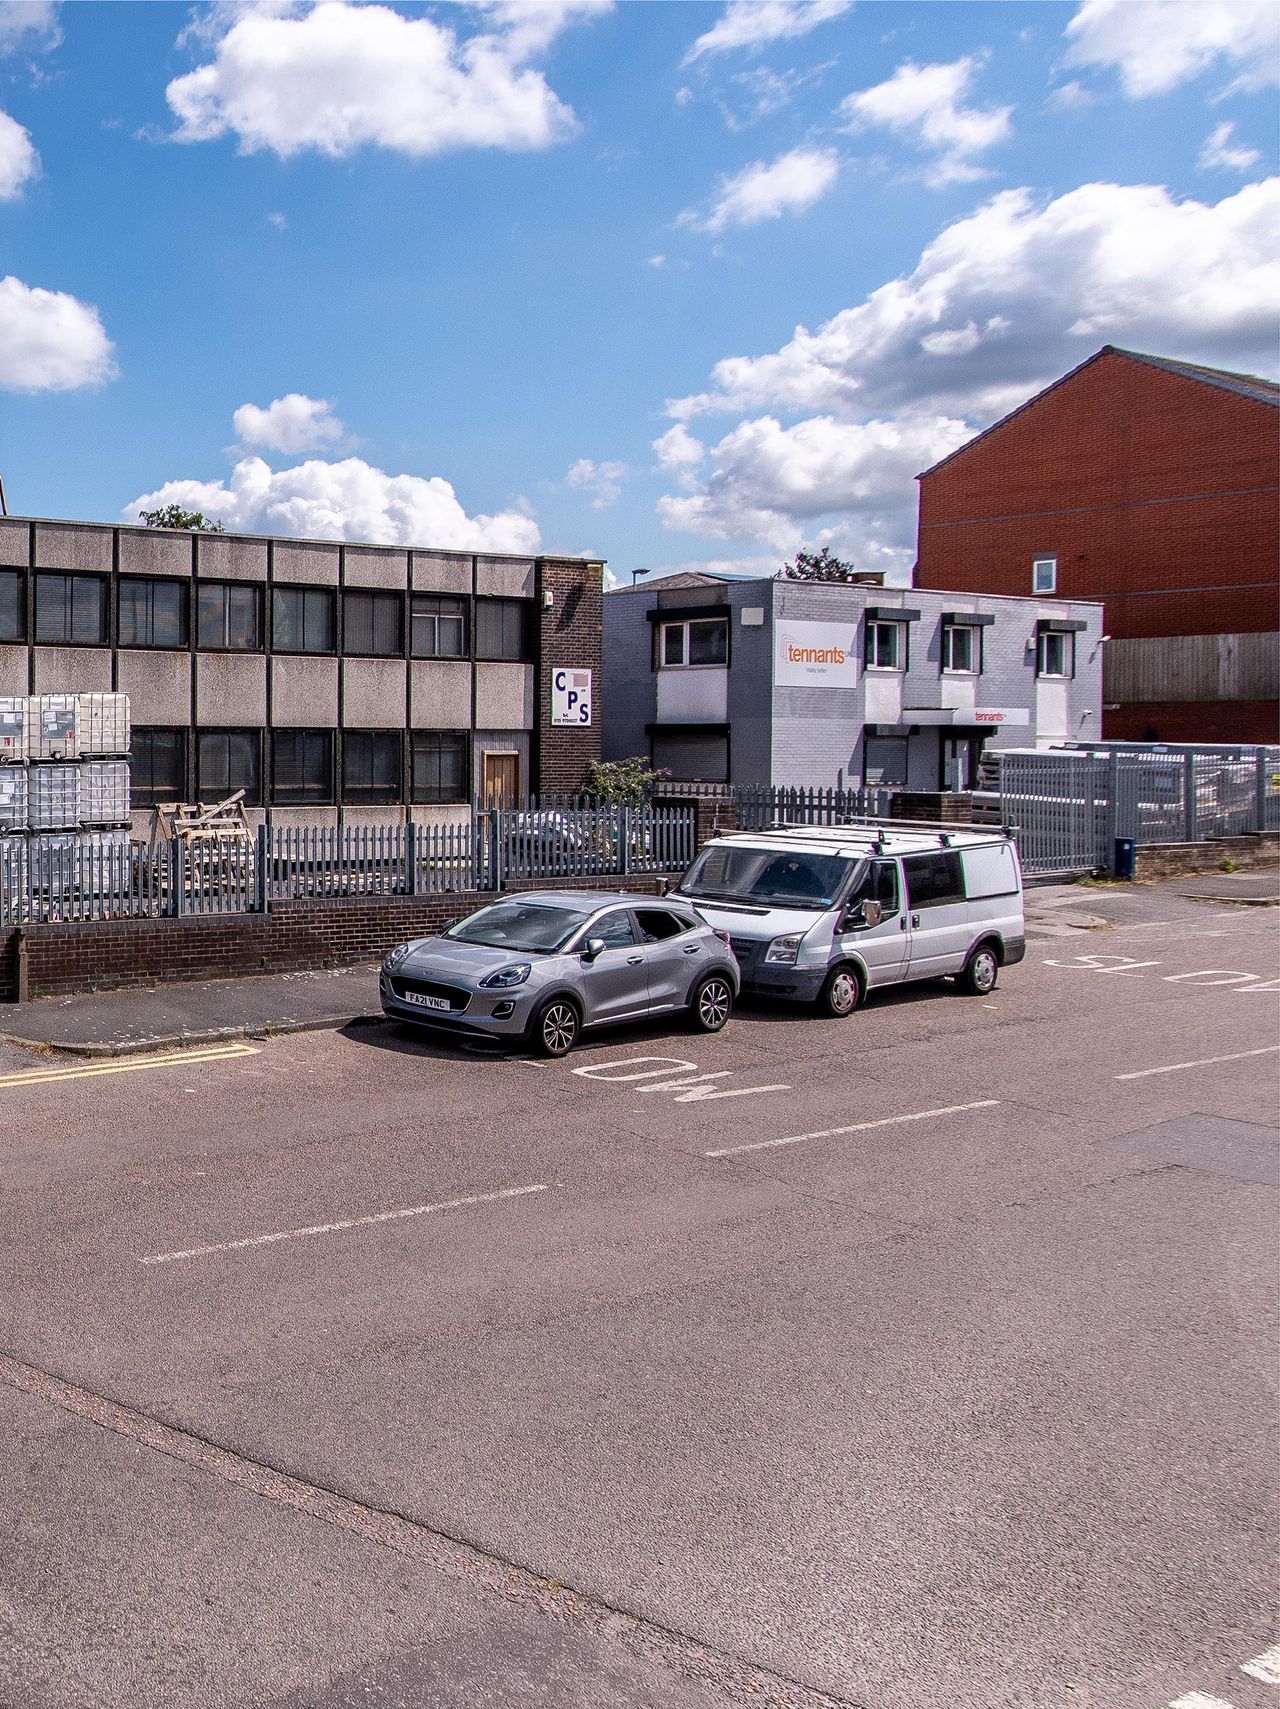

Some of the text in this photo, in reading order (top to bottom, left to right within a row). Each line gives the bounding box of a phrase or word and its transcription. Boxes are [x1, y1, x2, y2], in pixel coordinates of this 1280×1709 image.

[788, 645, 845, 664] tennants
[410, 993, 445, 1009] FA21 VNC
